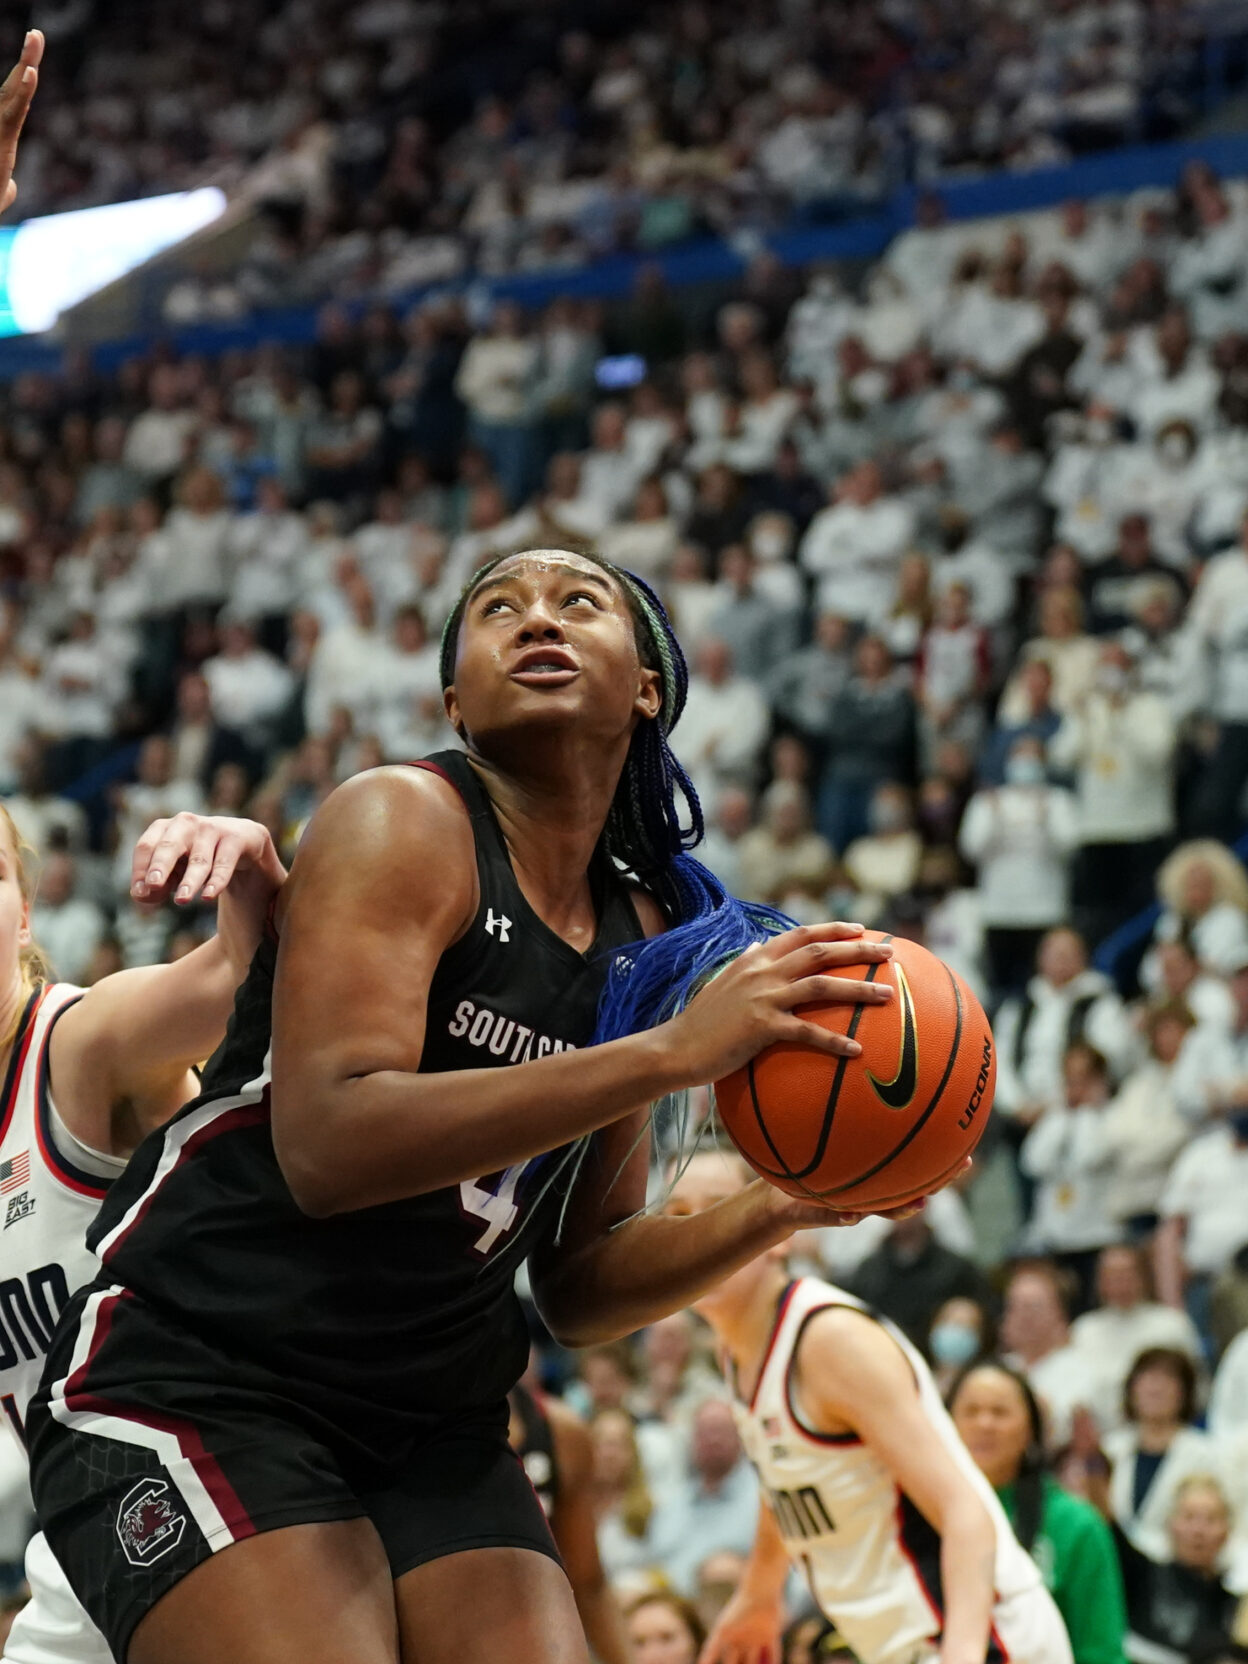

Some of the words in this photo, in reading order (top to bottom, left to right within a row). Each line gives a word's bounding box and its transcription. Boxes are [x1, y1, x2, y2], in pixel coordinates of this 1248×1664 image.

[958, 1036, 992, 1131] UCONN
[5, 1198, 36, 1223] EAST
[7, 1190, 29, 1212] BIG
